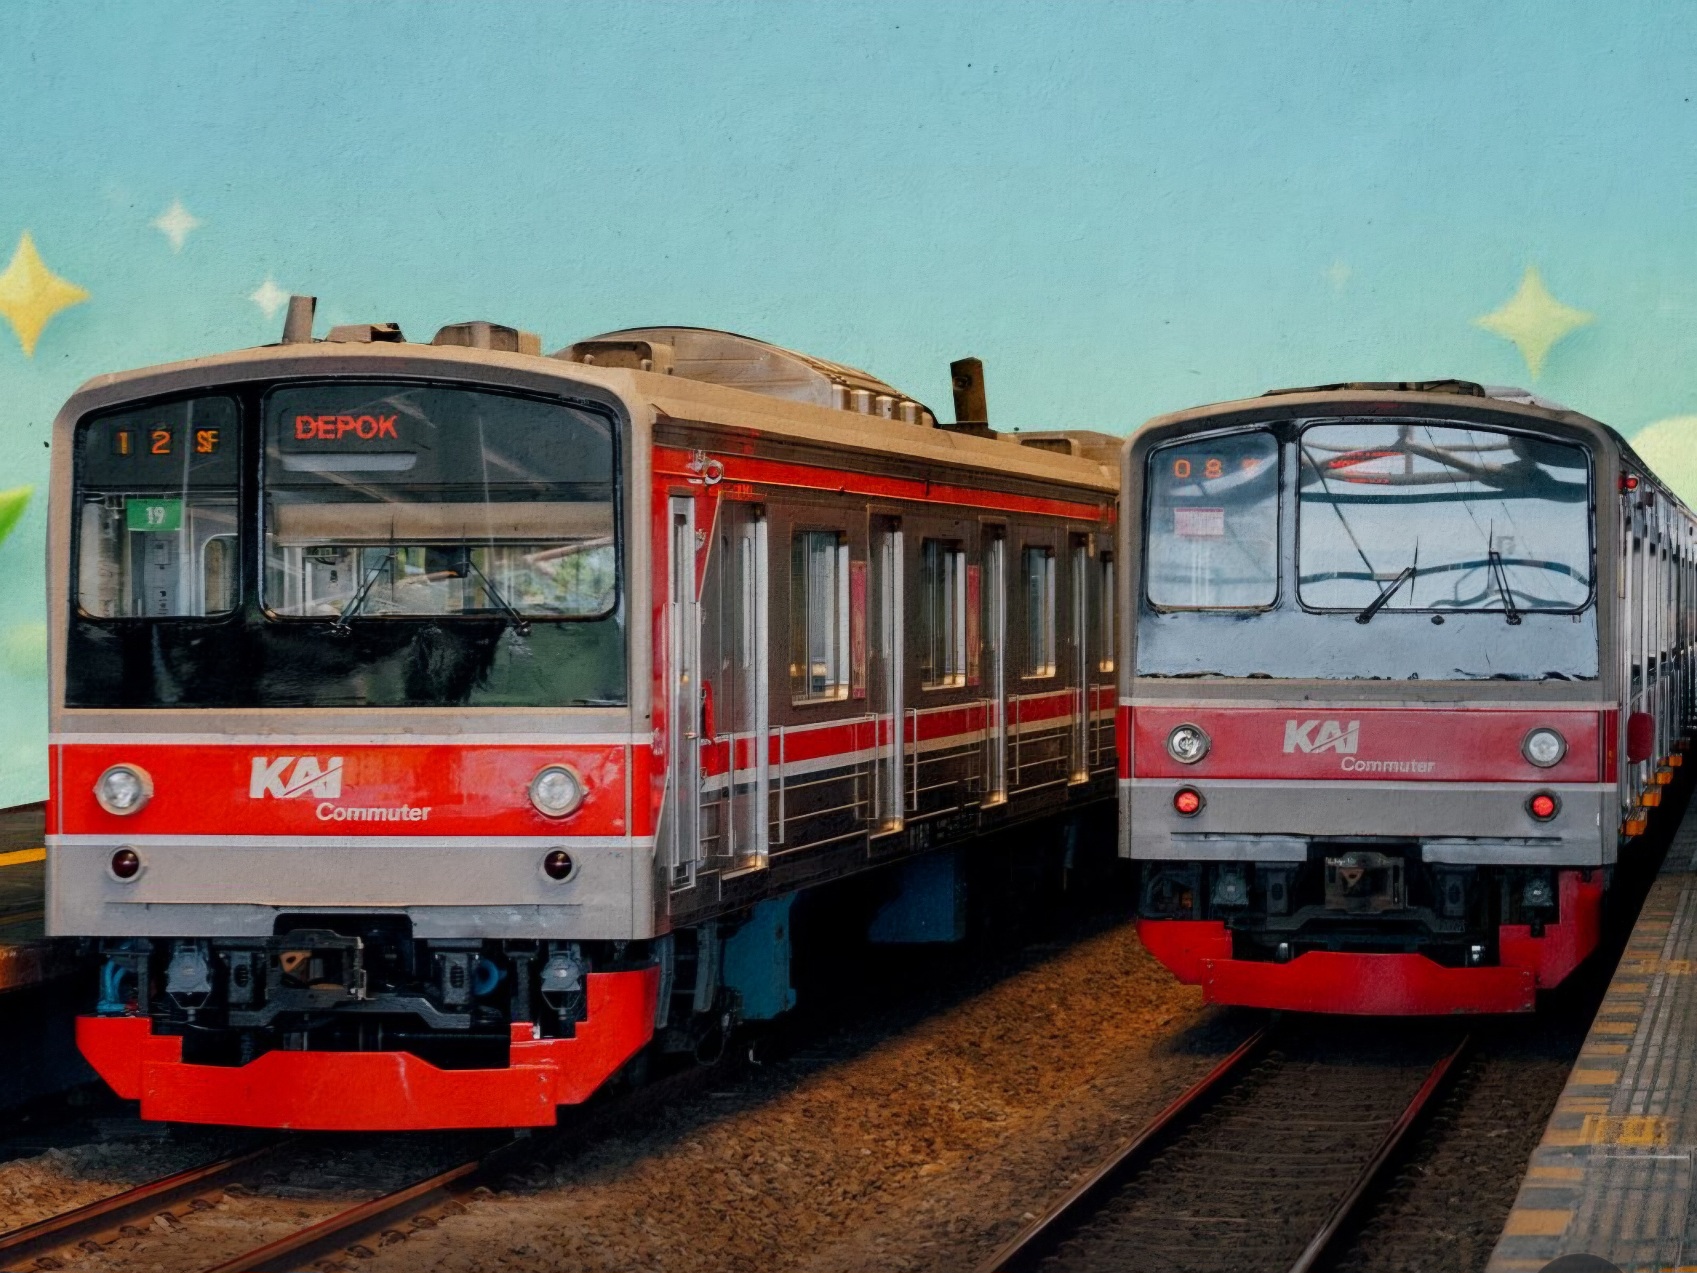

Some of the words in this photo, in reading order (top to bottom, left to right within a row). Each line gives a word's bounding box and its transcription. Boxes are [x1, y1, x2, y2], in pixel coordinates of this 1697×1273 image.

[295, 415, 398, 439] DEPOK
[1283, 720, 1360, 754] KAI
[250, 756, 344, 799] KAI
[316, 802, 432, 822] Commuter
